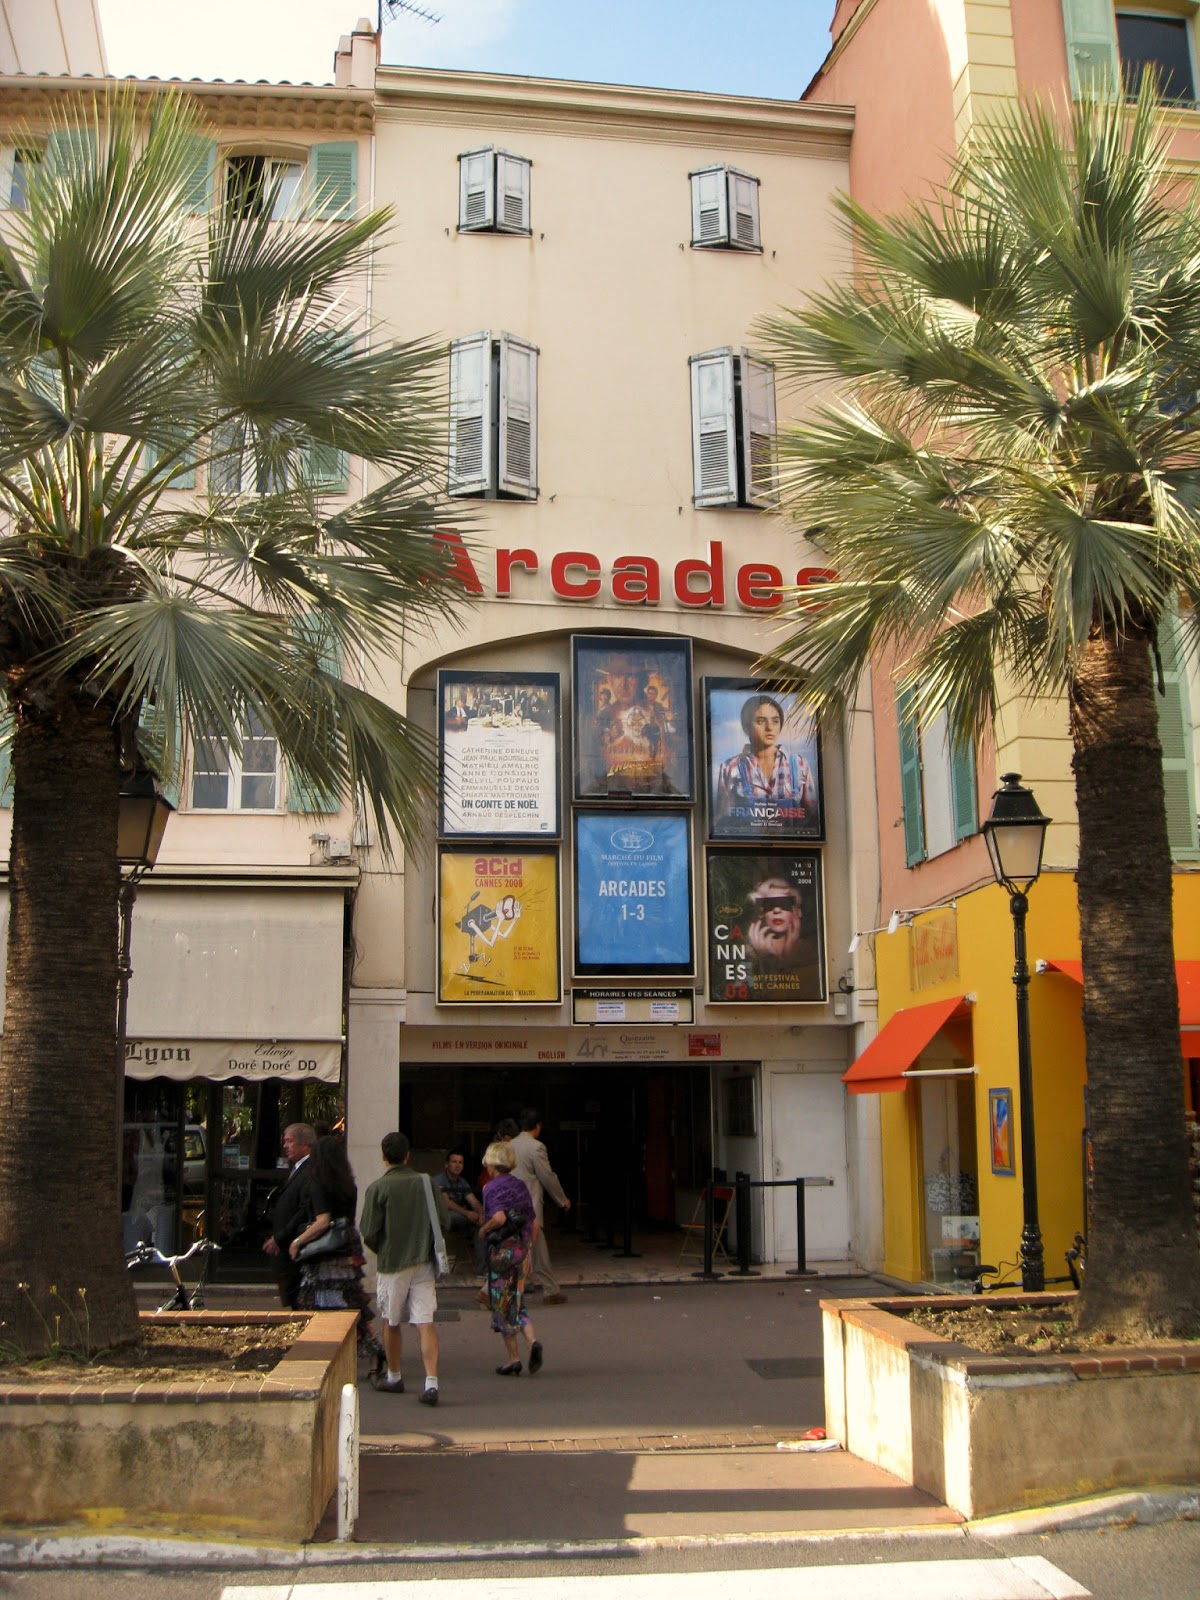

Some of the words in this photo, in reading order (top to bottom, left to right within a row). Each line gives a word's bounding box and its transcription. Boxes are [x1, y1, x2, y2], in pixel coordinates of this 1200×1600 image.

[423, 526, 841, 614] Arcades
[461, 747, 502, 755] CATHERINE
[505, 747, 539, 755] DENEUVE
[461, 800, 473, 809] UN
[475, 800, 502, 809] CONTE
[504, 800, 515, 809] DE
[517, 799, 539, 809] NOËL
[728, 806, 806, 819] FRANÇAISE
[600, 853, 632, 861] MARCHÉ
[474, 857, 523, 876] acid
[474, 879, 503, 888] CANNES
[505, 879, 523, 888] 2008
[598, 880, 667, 897] ARCADES
[621, 903, 645, 921] 1-3
[725, 983, 749, 1000] 08
[753, 982, 764, 990] DE
[766, 982, 800, 990] CANNES
[253, 1042, 296, 1060] Edwige
[432, 1041, 452, 1049] FILMS
[455, 1041, 464, 1049] EN
[465, 1041, 493, 1049] VERSION
[494, 1041, 528, 1049] ORIGINALE
[125, 1041, 191, 1065] Lyon
[538, 1051, 566, 1059] ENGLISH
[228, 1059, 257, 1071] Doré
[262, 1059, 291, 1071] Doré
[298, 1060, 317, 1071] DD
